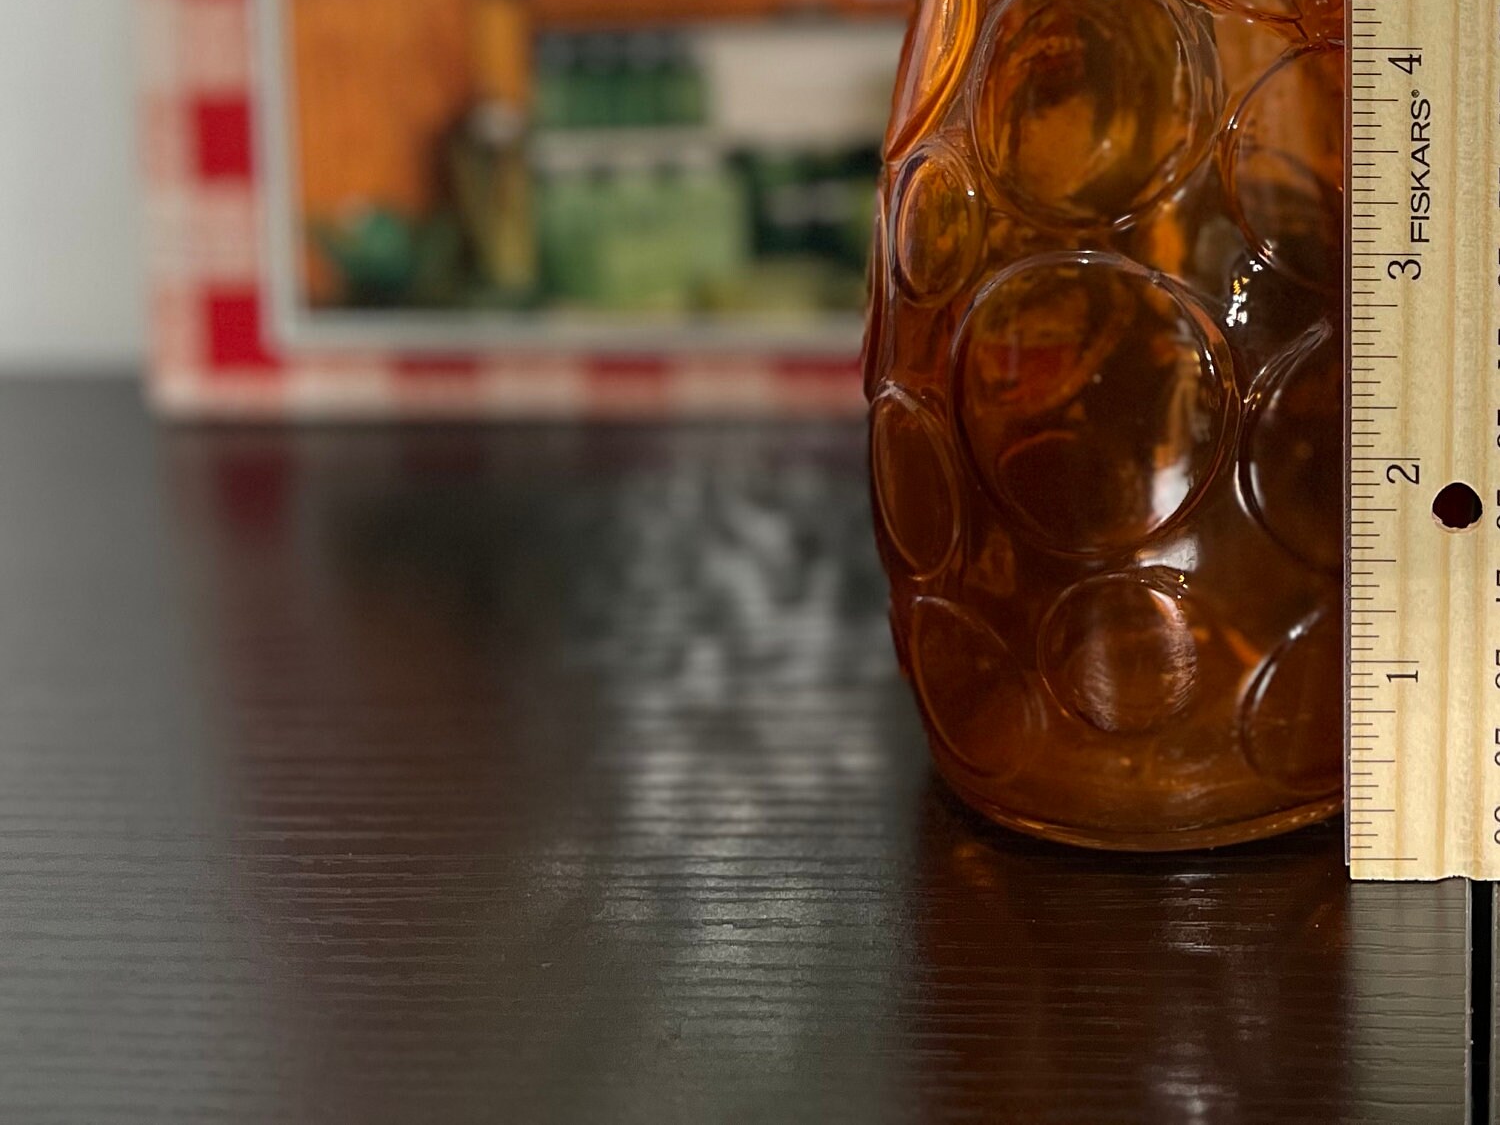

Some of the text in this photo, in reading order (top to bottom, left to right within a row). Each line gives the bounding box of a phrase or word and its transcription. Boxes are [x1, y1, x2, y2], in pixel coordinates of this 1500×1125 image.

[1388, 54, 1422, 75] 4
[1388, 259, 1421, 281] 3
[1387, 464, 1420, 485] 2
[1387, 670, 1419, 683] 1
